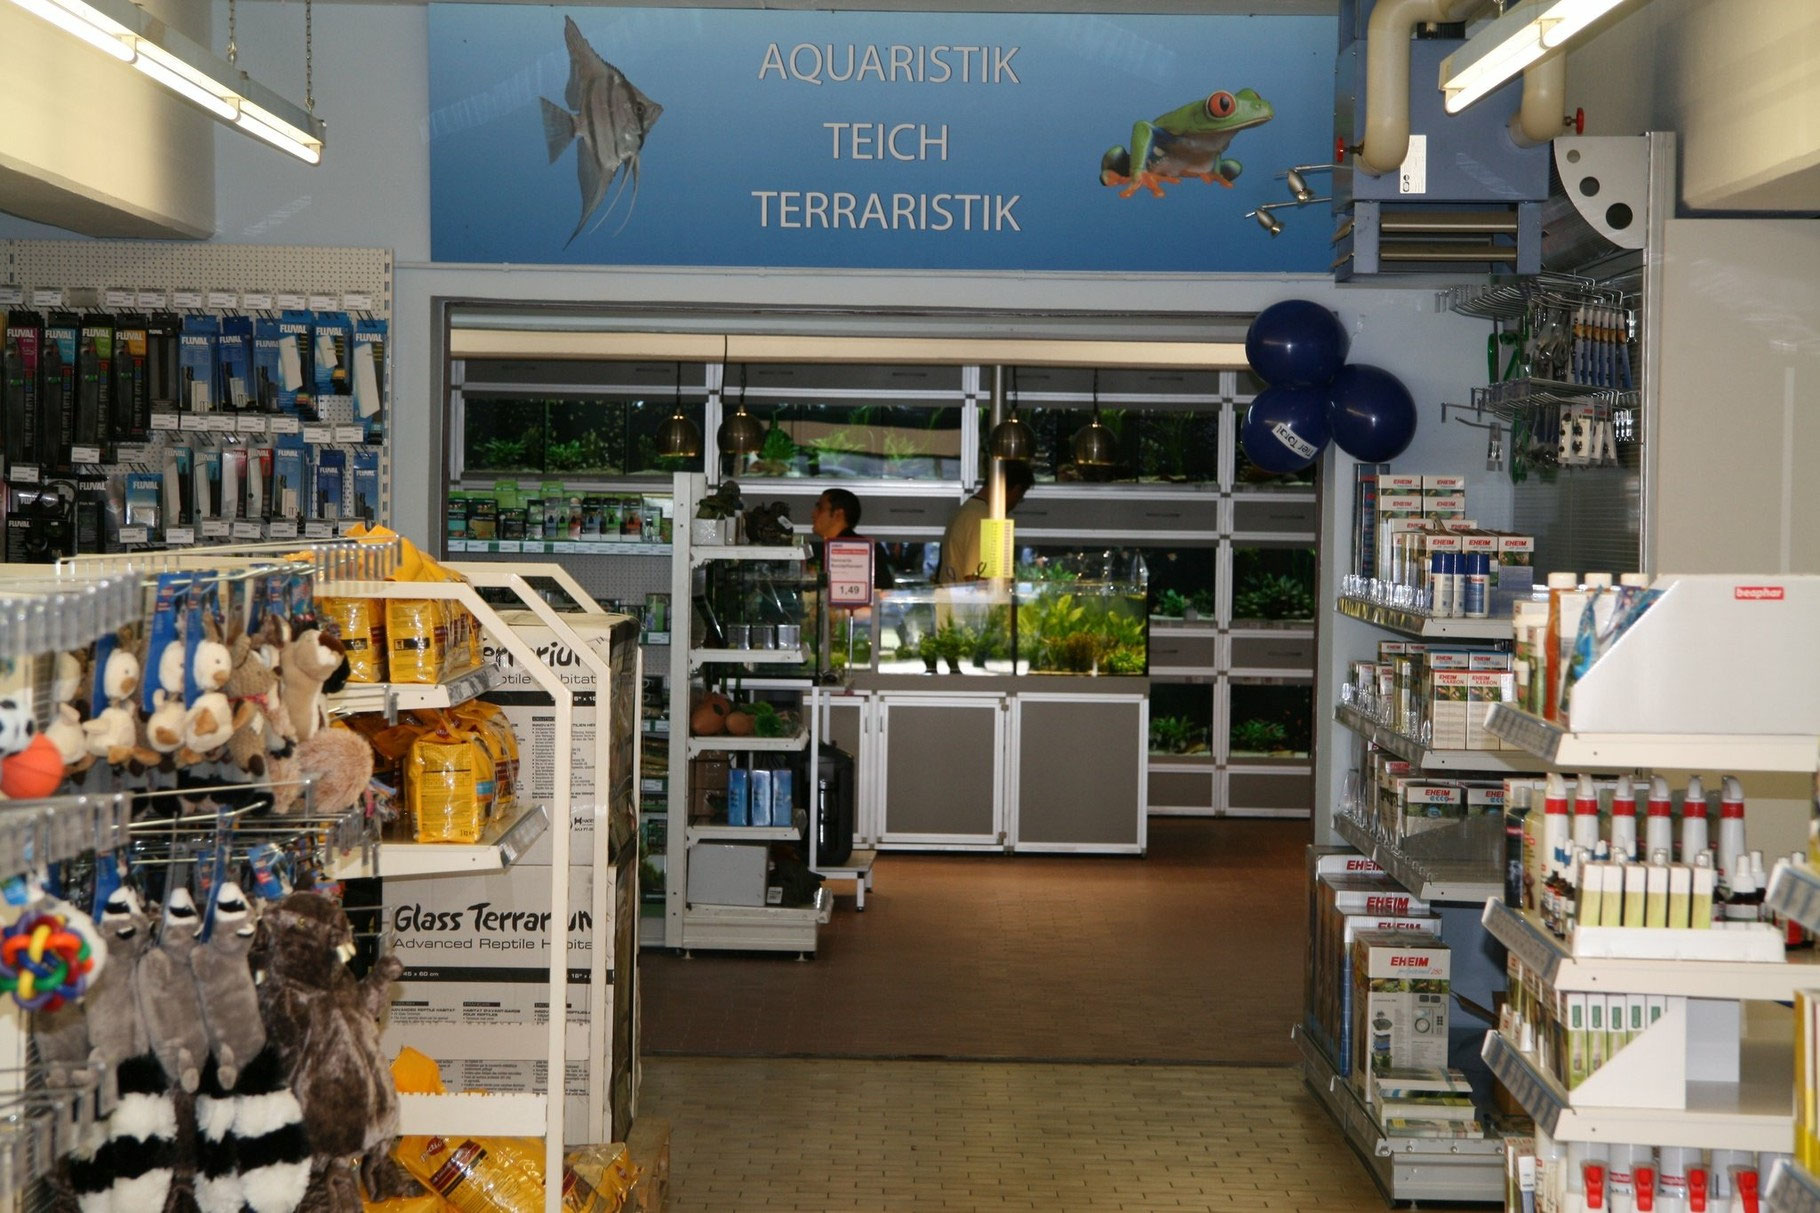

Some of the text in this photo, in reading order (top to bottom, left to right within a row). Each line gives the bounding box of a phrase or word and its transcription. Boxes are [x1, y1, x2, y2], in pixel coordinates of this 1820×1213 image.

[758, 43, 1021, 85] AQUARISTIK
[823, 122, 949, 161] TEICH
[751, 191, 1022, 231] TERRARISTIK
[7, 328, 35, 338] FLUVAL
[82, 328, 110, 338] FLUVAL
[280, 324, 307, 334] FLUVAL
[316, 326, 343, 336] FLUVAL
[45, 330, 73, 339] FLUVAL
[115, 331, 144, 341] FLUVAL
[219, 335, 242, 344] FLUVAL
[355, 332, 383, 342] FLUVAL
[181, 336, 208, 345] FLUVAL
[255, 339, 280, 348] FLUVA
[79, 482, 106, 491] FLUVAL
[133, 481, 158, 490] FLUVAL
[8, 520, 30, 528] FLUVAL
[840, 585, 860, 595] 1,49
[1736, 588, 1782, 599] beaphar
[1347, 860, 1385, 871] EHEI
[1367, 897, 1409, 910] EHEIM
[395, 903, 463, 932] Glass
[393, 938, 472, 949] Advanced
[480, 938, 534, 951] Reptile
[1390, 957, 1429, 967] EHEIM
